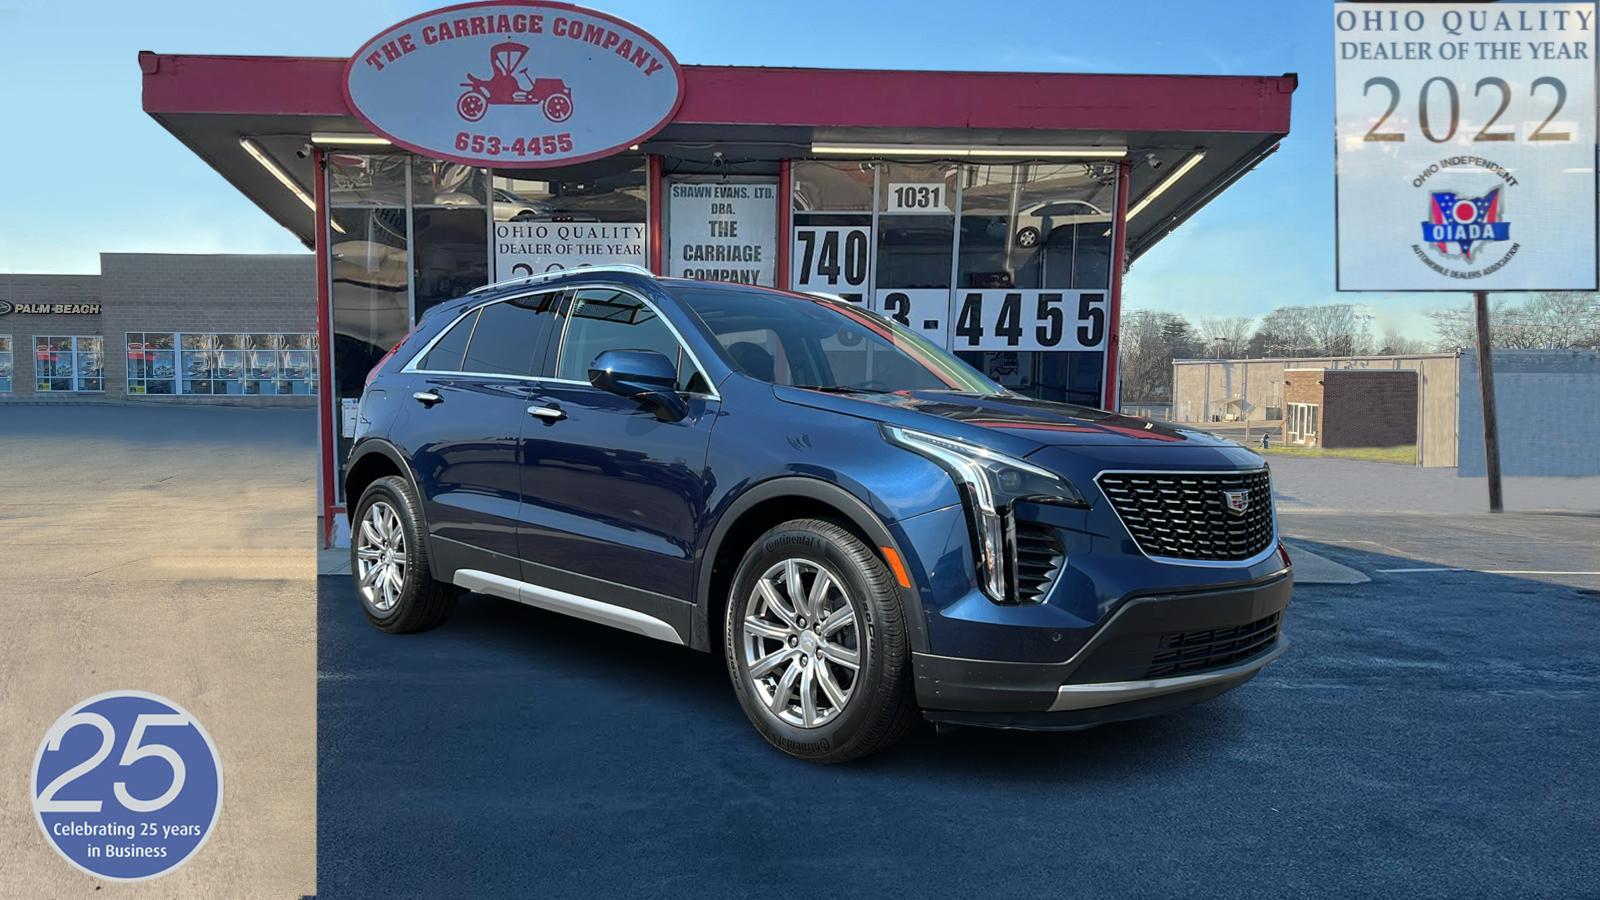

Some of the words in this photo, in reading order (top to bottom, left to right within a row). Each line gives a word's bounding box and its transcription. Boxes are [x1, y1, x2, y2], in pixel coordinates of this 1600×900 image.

[1336, 10, 1425, 31] OHIO
[1442, 10, 1592, 35] QUALITY
[365, 33, 416, 71] THE
[422, 15, 543, 46] CARRIAGE
[553, 17, 664, 77] COMPANY
[1340, 42, 1433, 60] DEALER
[1438, 42, 1469, 60] OF
[1475, 42, 1522, 60] THE
[1528, 42, 1589, 60] YEAR
[1363, 76, 1570, 143] 2022
[455, 132, 573, 156] 653-4455
[1412, 163, 1439, 188] OHIO
[1440, 156, 1519, 187] INDEPENDENT
[673, 186, 712, 198] SHAWN
[754, 188, 775, 199] LTD.
[894, 187, 940, 208] 1031
[711, 203, 736, 215] DBA.
[497, 226, 548, 238] OHIO
[557, 226, 643, 240] QUALITY
[708, 221, 738, 237] THE
[1432, 224, 1495, 240] OIADA
[500, 244, 552, 255] DEALER
[555, 244, 573, 255] OF
[576, 244, 603, 255] THE
[607, 244, 641, 255] YEAR
[683, 244, 762, 262] CARRIAGE
[798, 230, 867, 286] 740
[1411, 244, 1449, 277] AUTOMOBILE
[1449, 270, 1482, 279] DEALERS
[1483, 242, 1520, 275] ASSOCIATION
[683, 268, 761, 285] COMPANY
[14, 304, 51, 314] PALM
[54, 304, 100, 314] BEACH
